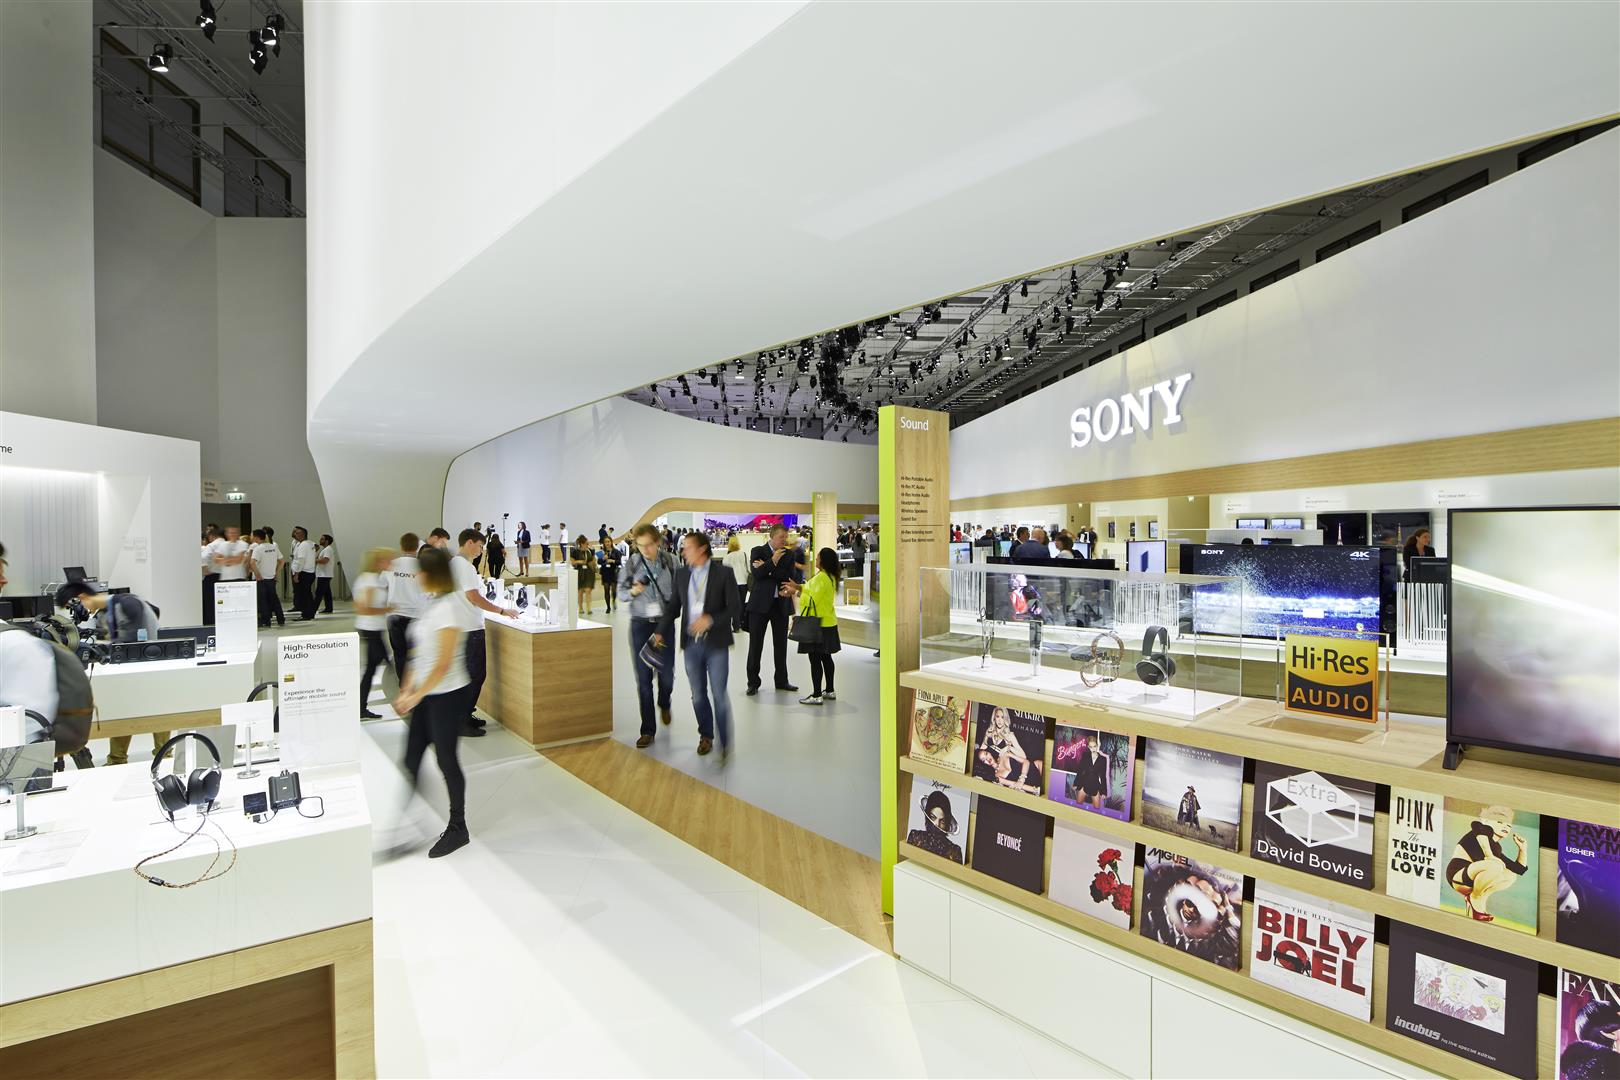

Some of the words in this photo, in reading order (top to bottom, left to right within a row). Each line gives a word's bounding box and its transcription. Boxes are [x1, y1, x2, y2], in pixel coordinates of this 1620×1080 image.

[1071, 372, 1192, 448] SONY
[900, 416, 929, 431] Sound
[283, 641, 349, 653] High-Resolution
[283, 652, 309, 660] Audio
[1292, 645, 1370, 676] Hi-Res
[1292, 687, 1369, 712] AUDIO
[1012, 723, 1045, 735] RIHANNA
[1287, 778, 1339, 803] Extra
[1396, 796, 1434, 832] P!NK
[996, 832, 1022, 852] BEYONCÉ
[1392, 838, 1436, 857] TRUTH
[1565, 846, 1595, 858] USHER
[1147, 847, 1192, 868] MIGUEL
[1257, 839, 1304, 864] David
[1309, 853, 1364, 880] Bowie
[1394, 850, 1432, 866] ABOUT
[1391, 858, 1435, 880] LOVE
[1292, 906, 1307, 916] THE
[1312, 912, 1333, 923] HITS
[1257, 904, 1368, 960] BILLY
[1256, 932, 1366, 996] JOEL
[1394, 1015, 1441, 1041] incubus
